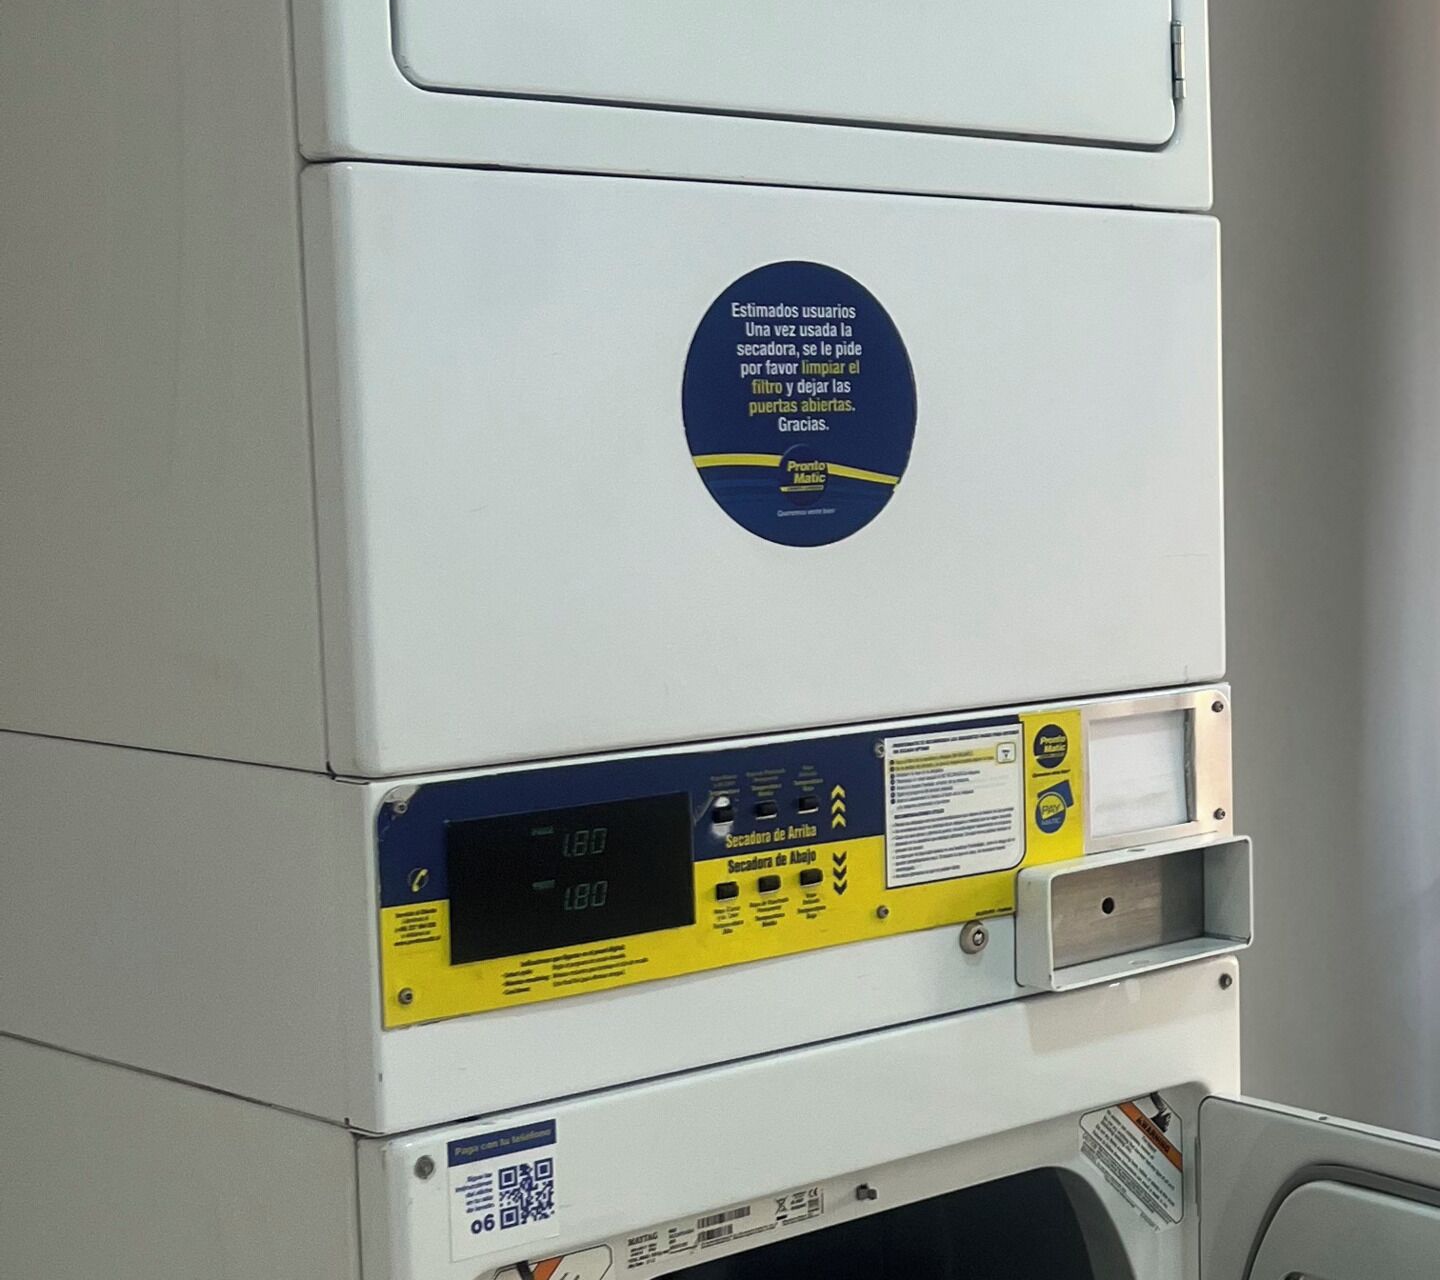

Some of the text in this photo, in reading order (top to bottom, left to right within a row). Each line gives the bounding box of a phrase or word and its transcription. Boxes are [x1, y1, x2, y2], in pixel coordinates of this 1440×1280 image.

[732, 302, 856, 318] Estimados usuarios
[746, 323, 852, 337] Una vez usada la
[737, 343, 862, 358] secadora, se le pide
[741, 361, 859, 378] por favor limpiar el
[752, 380, 851, 397] filtro y dejar las
[750, 398, 856, 416] puertas abiertas.
[778, 418, 829, 432] Gracias.
[788, 461, 825, 472] Pronto
[794, 472, 825, 484] Matic
[1042, 803, 1061, 816] PAY
[726, 825, 817, 848] Secadora de Arriba
[728, 848, 817, 873] Secadora de Abajo
[471, 1213, 495, 1234] 06
